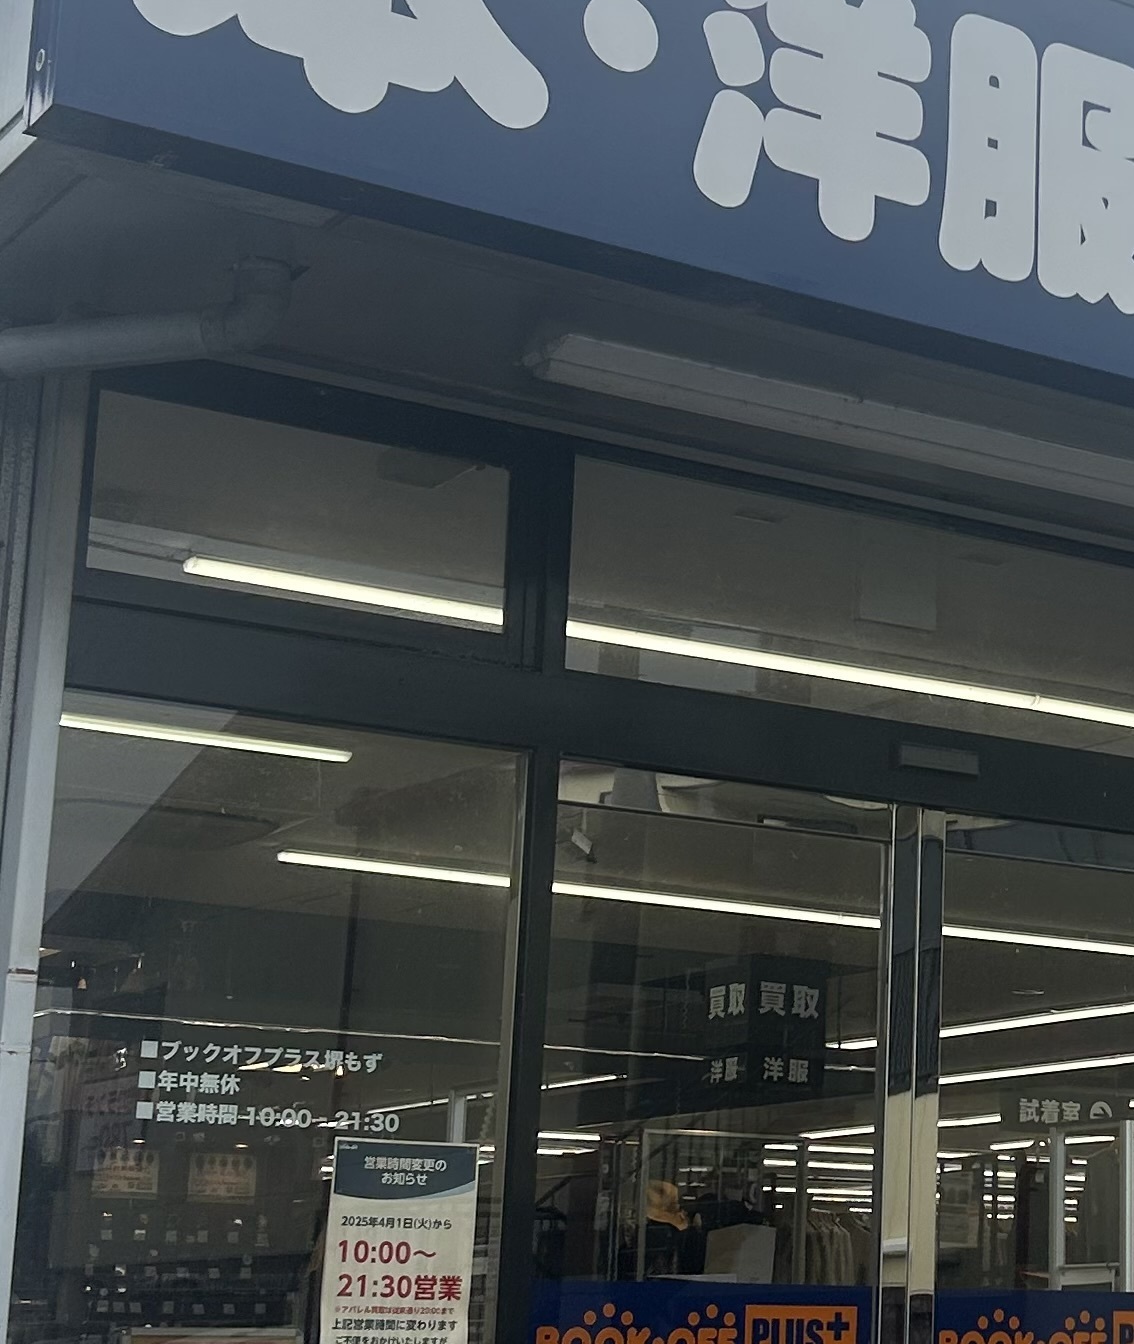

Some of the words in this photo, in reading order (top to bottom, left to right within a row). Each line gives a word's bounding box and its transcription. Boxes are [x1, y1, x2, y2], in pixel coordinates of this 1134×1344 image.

[758, 980, 820, 1019] 買取
[763, 1056, 809, 1083] 洋服
[157, 1070, 241, 1095] 年中無休
[156, 1101, 238, 1125] 営業時間
[1019, 1098, 1081, 1124] 試着室
[363, 1156, 447, 1172] 営業時間変更の
[381, 1172, 428, 1186] お知らせ
[336, 1273, 463, 1301] 21:30営業
